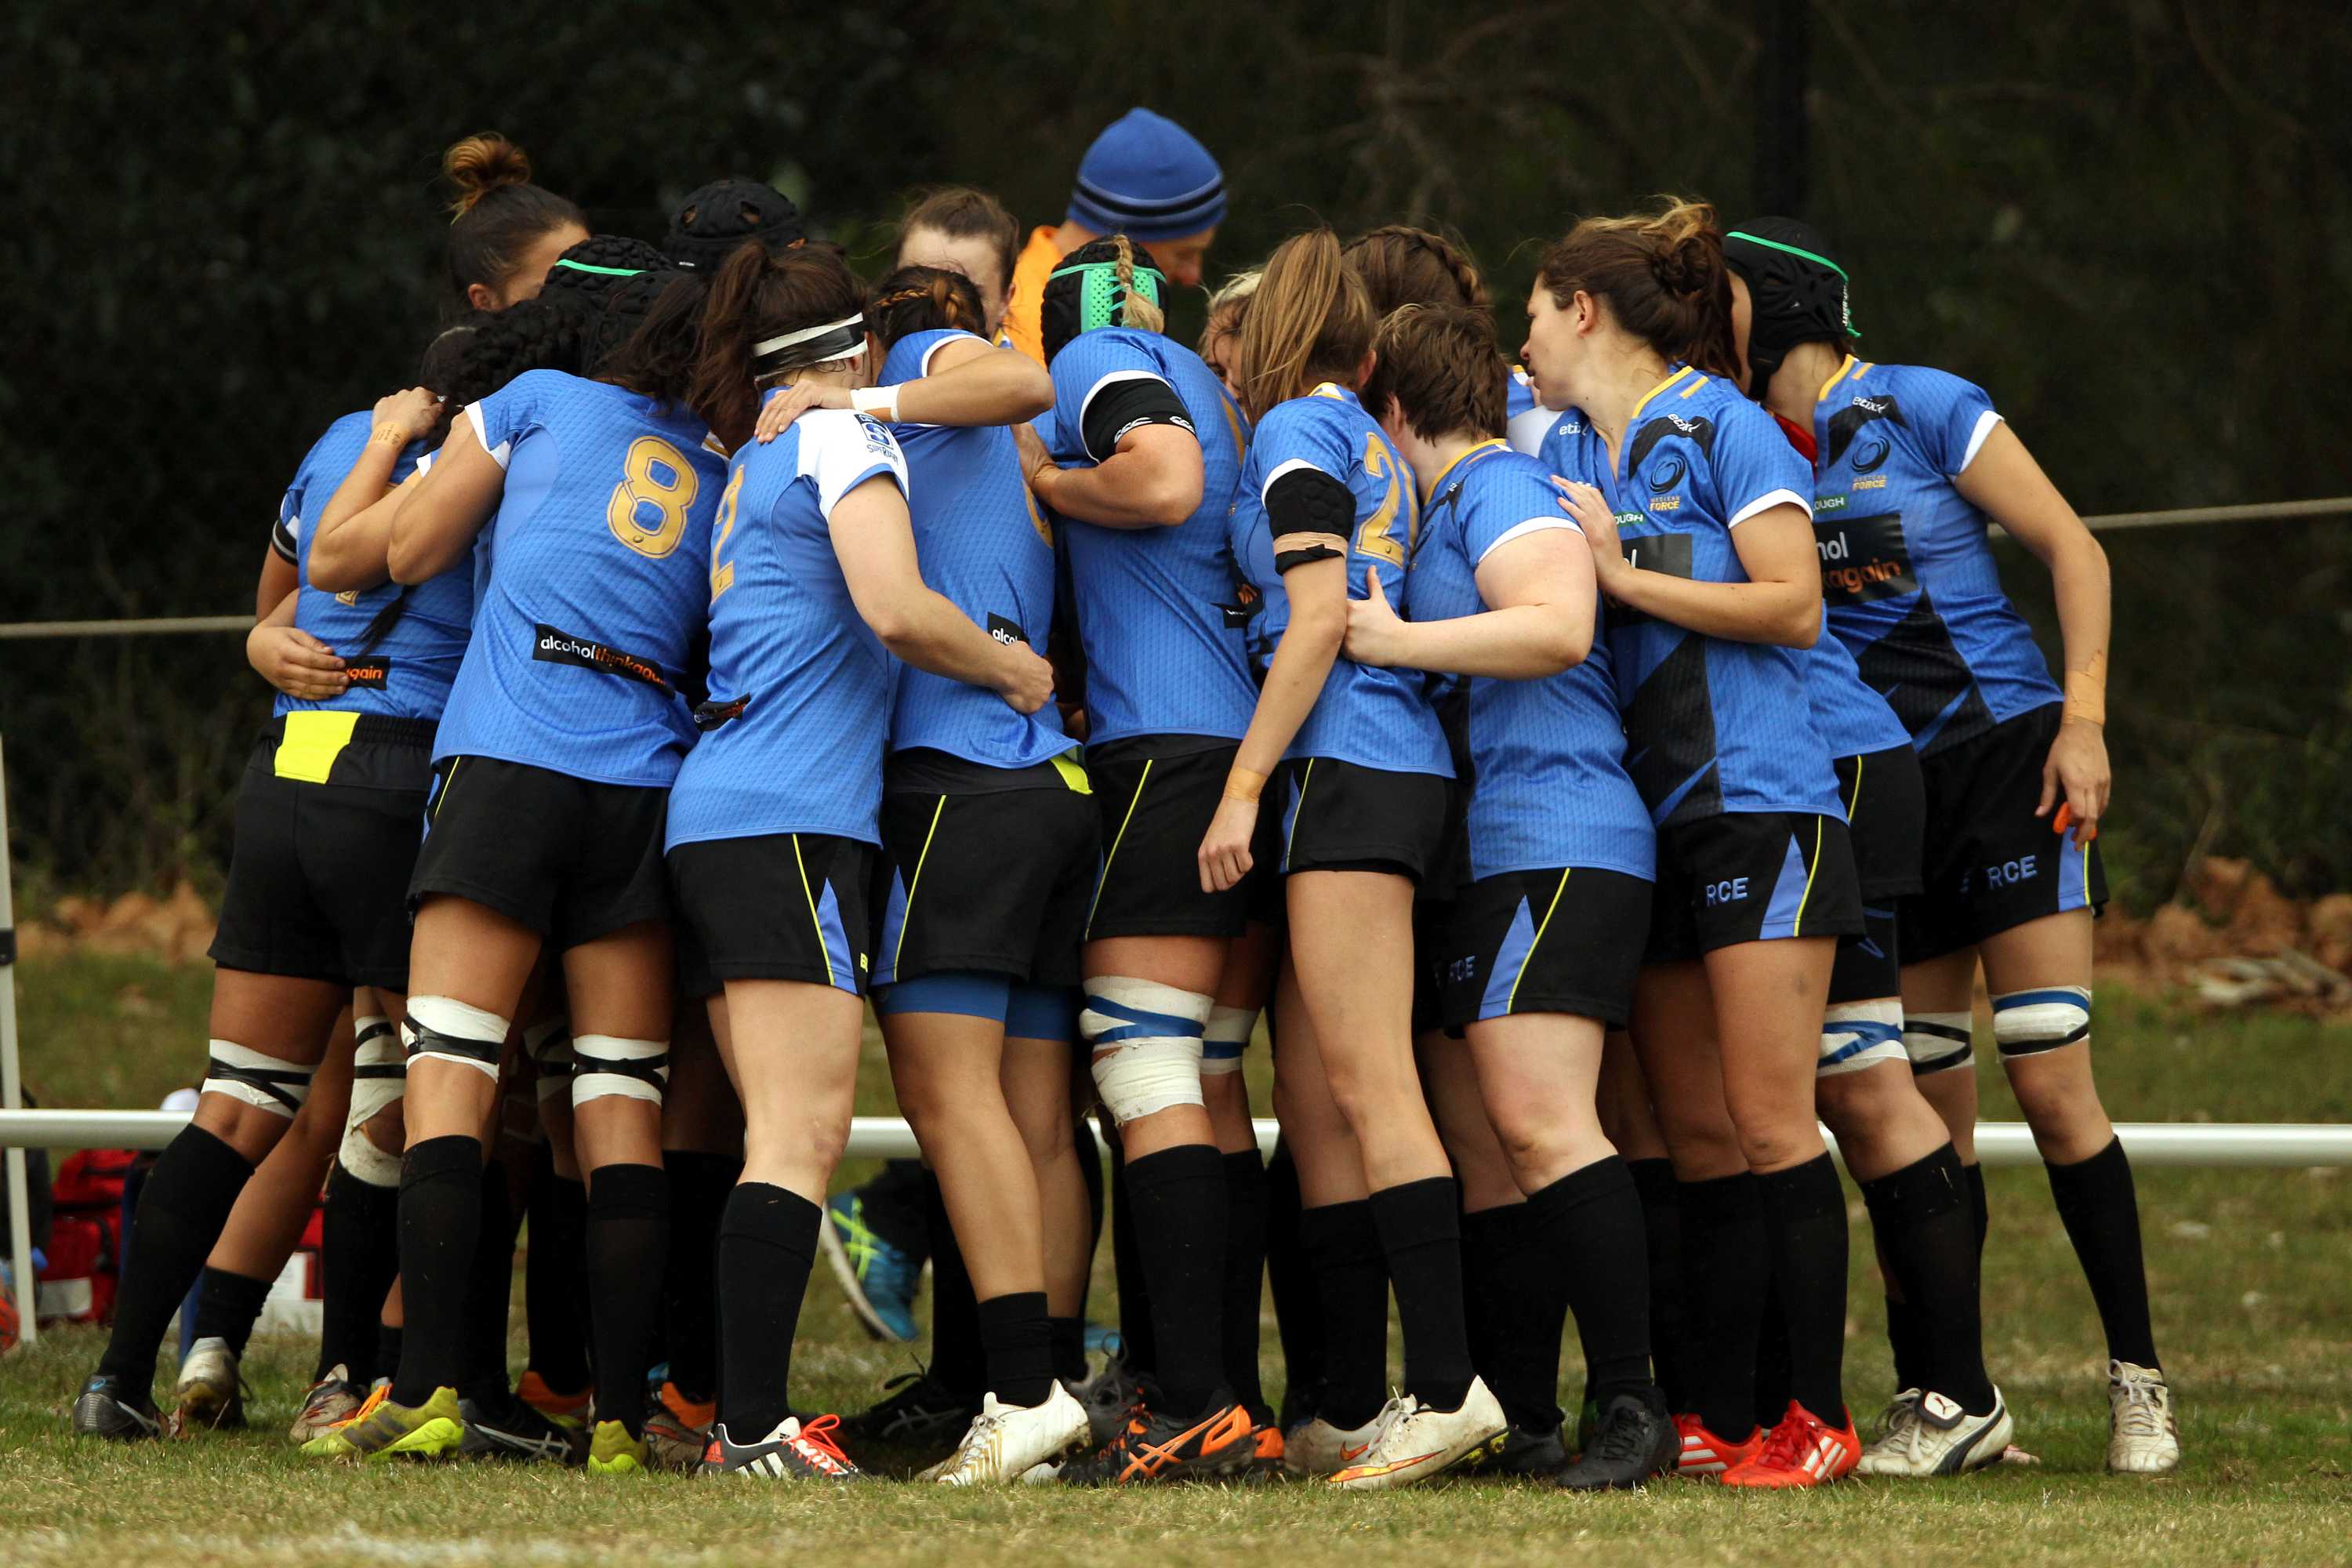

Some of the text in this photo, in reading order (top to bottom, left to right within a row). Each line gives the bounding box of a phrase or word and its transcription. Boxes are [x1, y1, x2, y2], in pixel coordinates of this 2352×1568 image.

[1853, 479, 1886, 492] FORCE
[607, 435, 699, 559] 8
[1813, 497, 1845, 511] OUGH
[1649, 500, 1680, 512] FORCE
[1823, 557, 1901, 594] again
